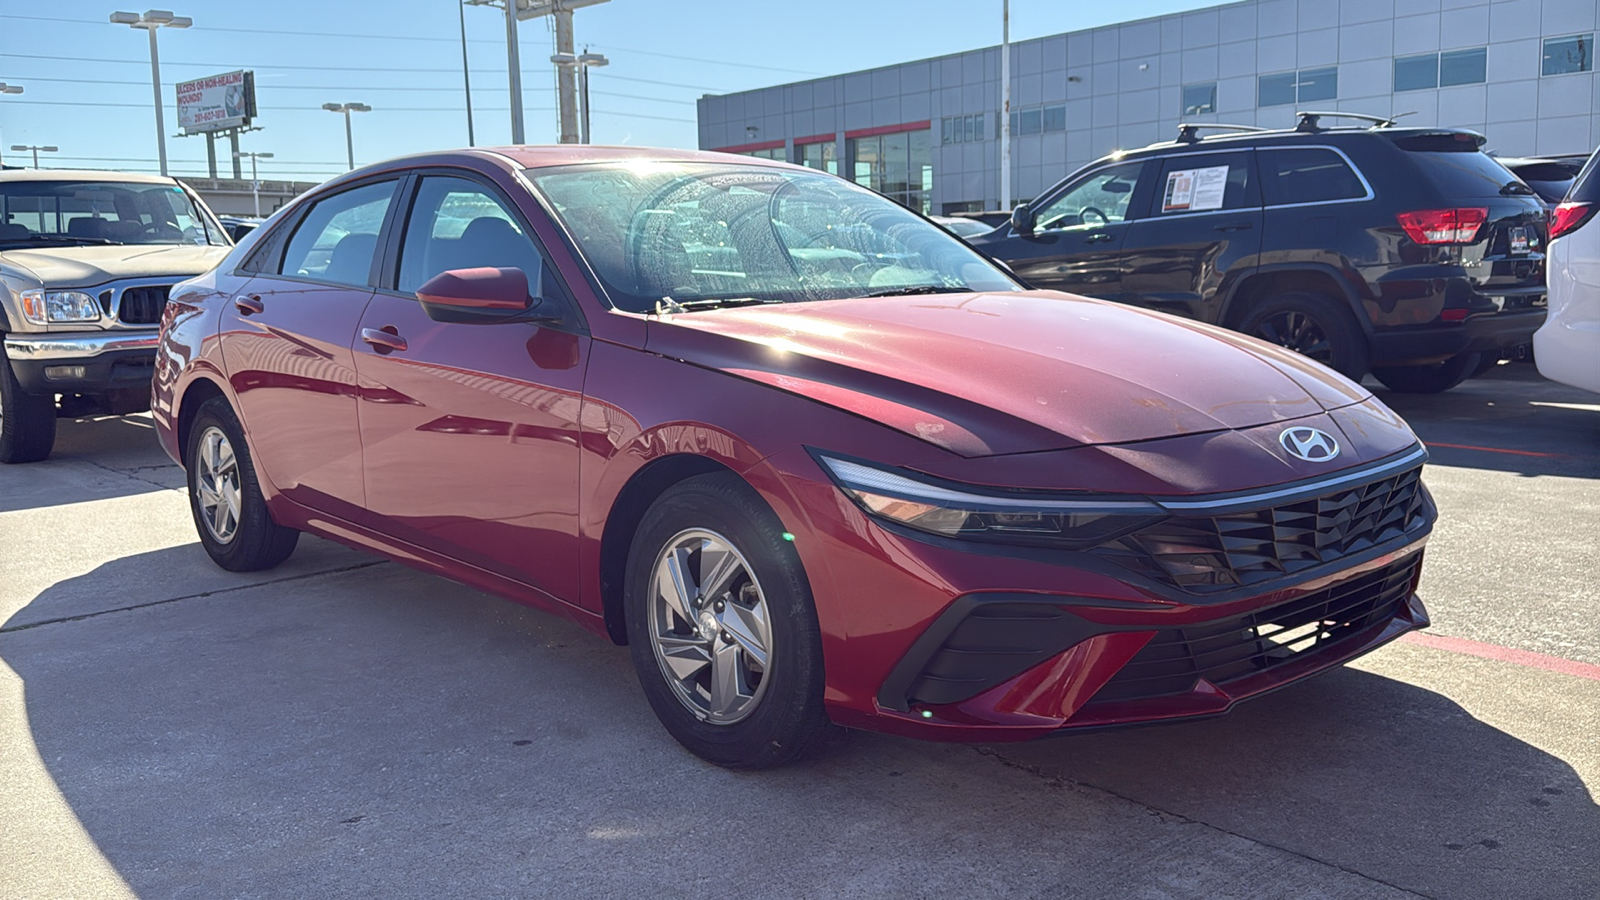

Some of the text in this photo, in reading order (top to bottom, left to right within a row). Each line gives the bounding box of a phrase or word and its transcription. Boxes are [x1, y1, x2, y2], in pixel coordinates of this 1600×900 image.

[196, 80, 203, 90] OR
[205, 73, 242, 89] NON-HEALING
[178, 92, 202, 105] WOUNDS?
